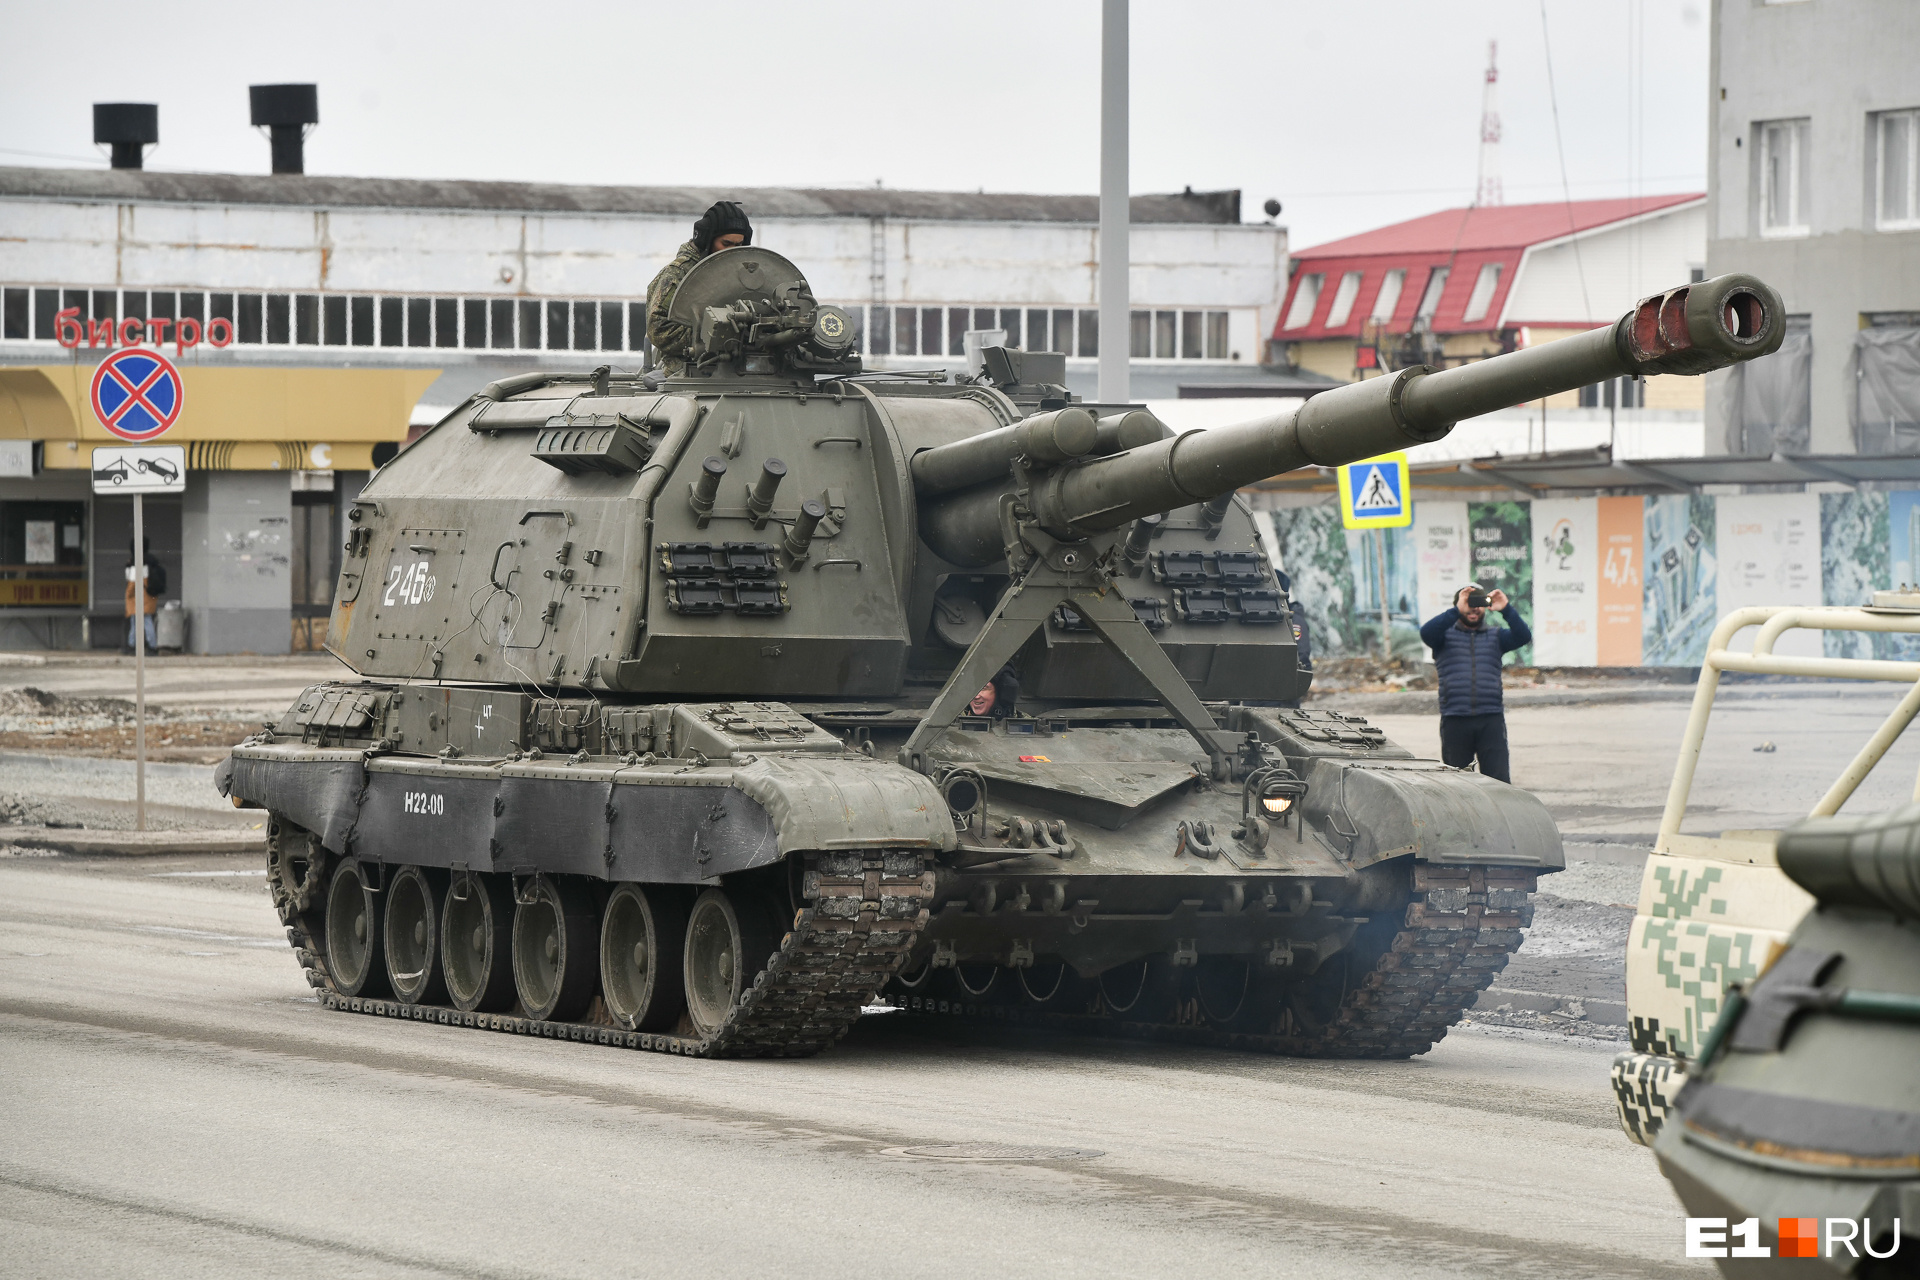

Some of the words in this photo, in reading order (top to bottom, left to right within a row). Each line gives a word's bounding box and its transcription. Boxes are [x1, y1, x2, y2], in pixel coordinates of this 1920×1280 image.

[54, 307, 233, 358] бистро
[1474, 528, 1501, 541] ВАШИ
[1475, 546, 1527, 560] СОЛНЕЧНЫЕ
[384, 562, 428, 606] 246
